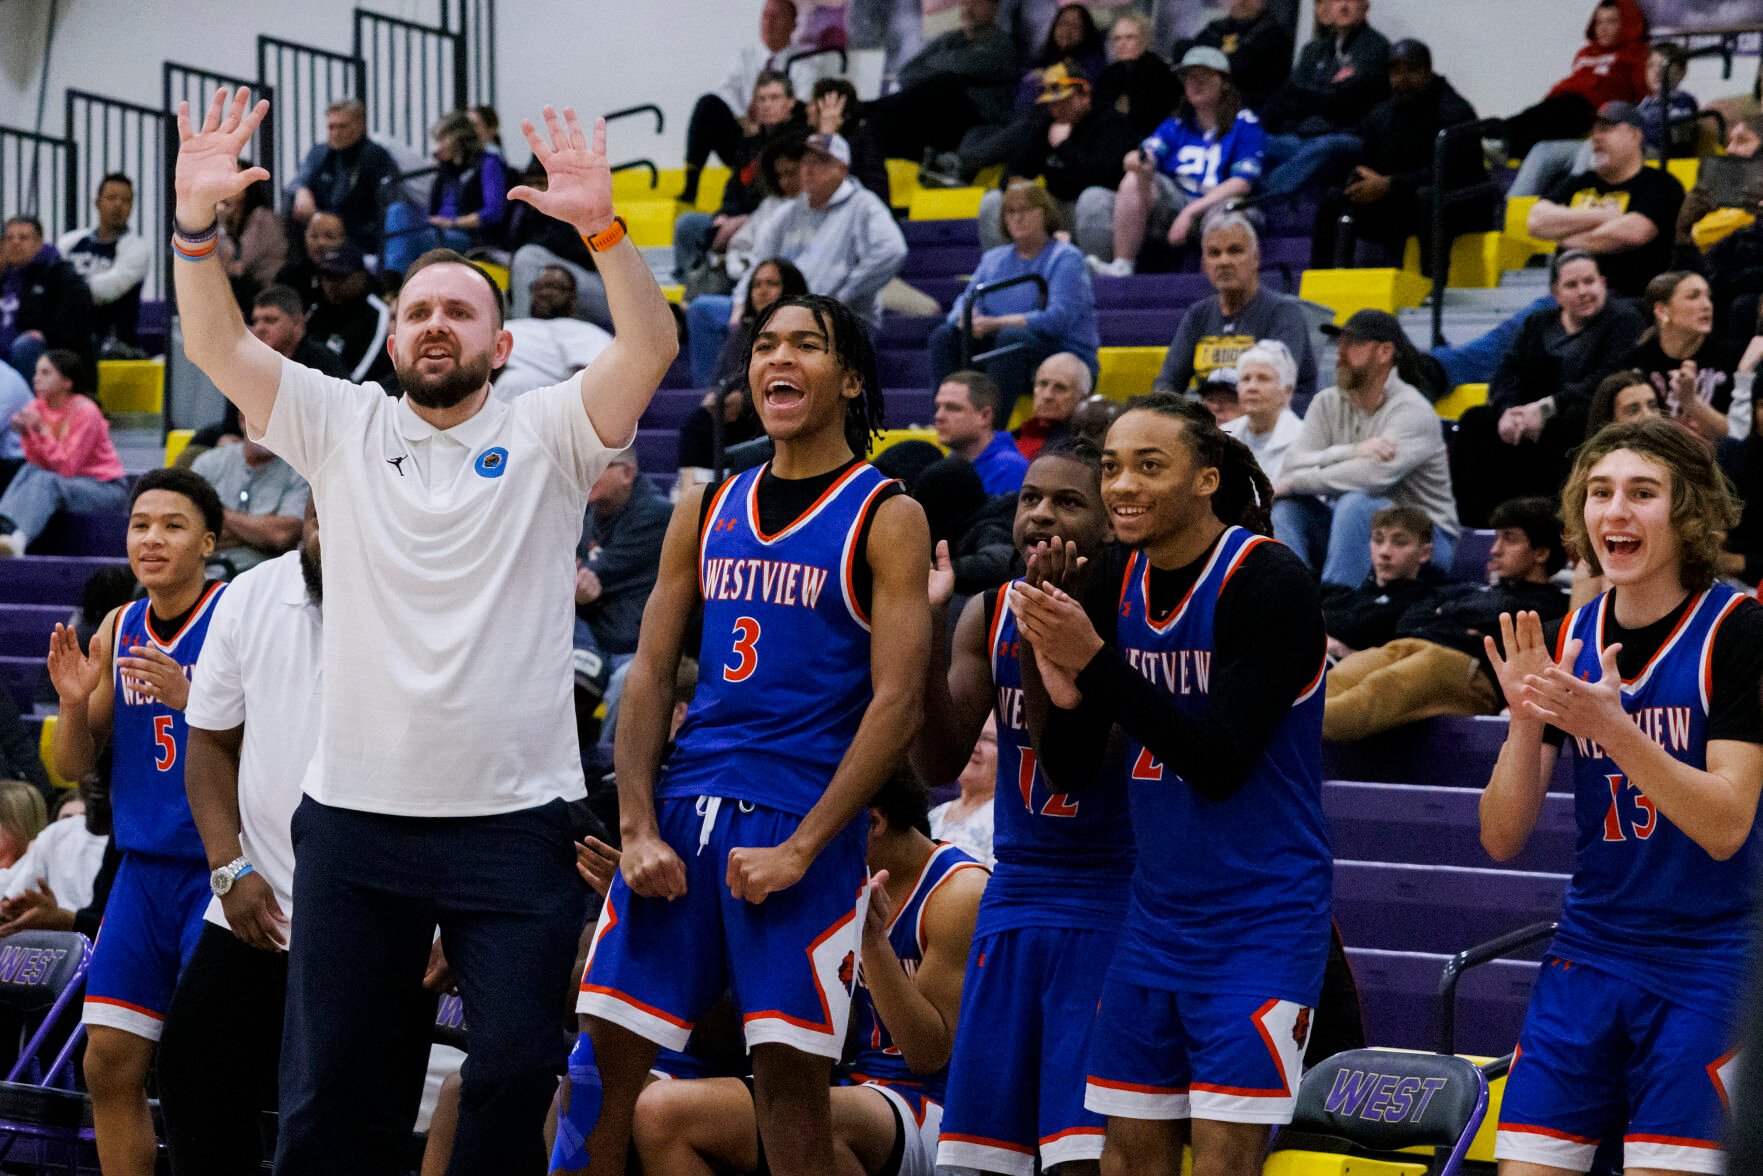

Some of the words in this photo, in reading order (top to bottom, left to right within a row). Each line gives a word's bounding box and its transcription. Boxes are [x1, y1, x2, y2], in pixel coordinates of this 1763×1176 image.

[1175, 143, 1222, 188] 21
[703, 558, 828, 610] WESTVIEW
[723, 616, 762, 683] 3
[153, 715, 177, 772] 5
[1602, 774, 1657, 841] 13
[0, 945, 68, 985] WEST
[1323, 1068, 1448, 1123] WEST
